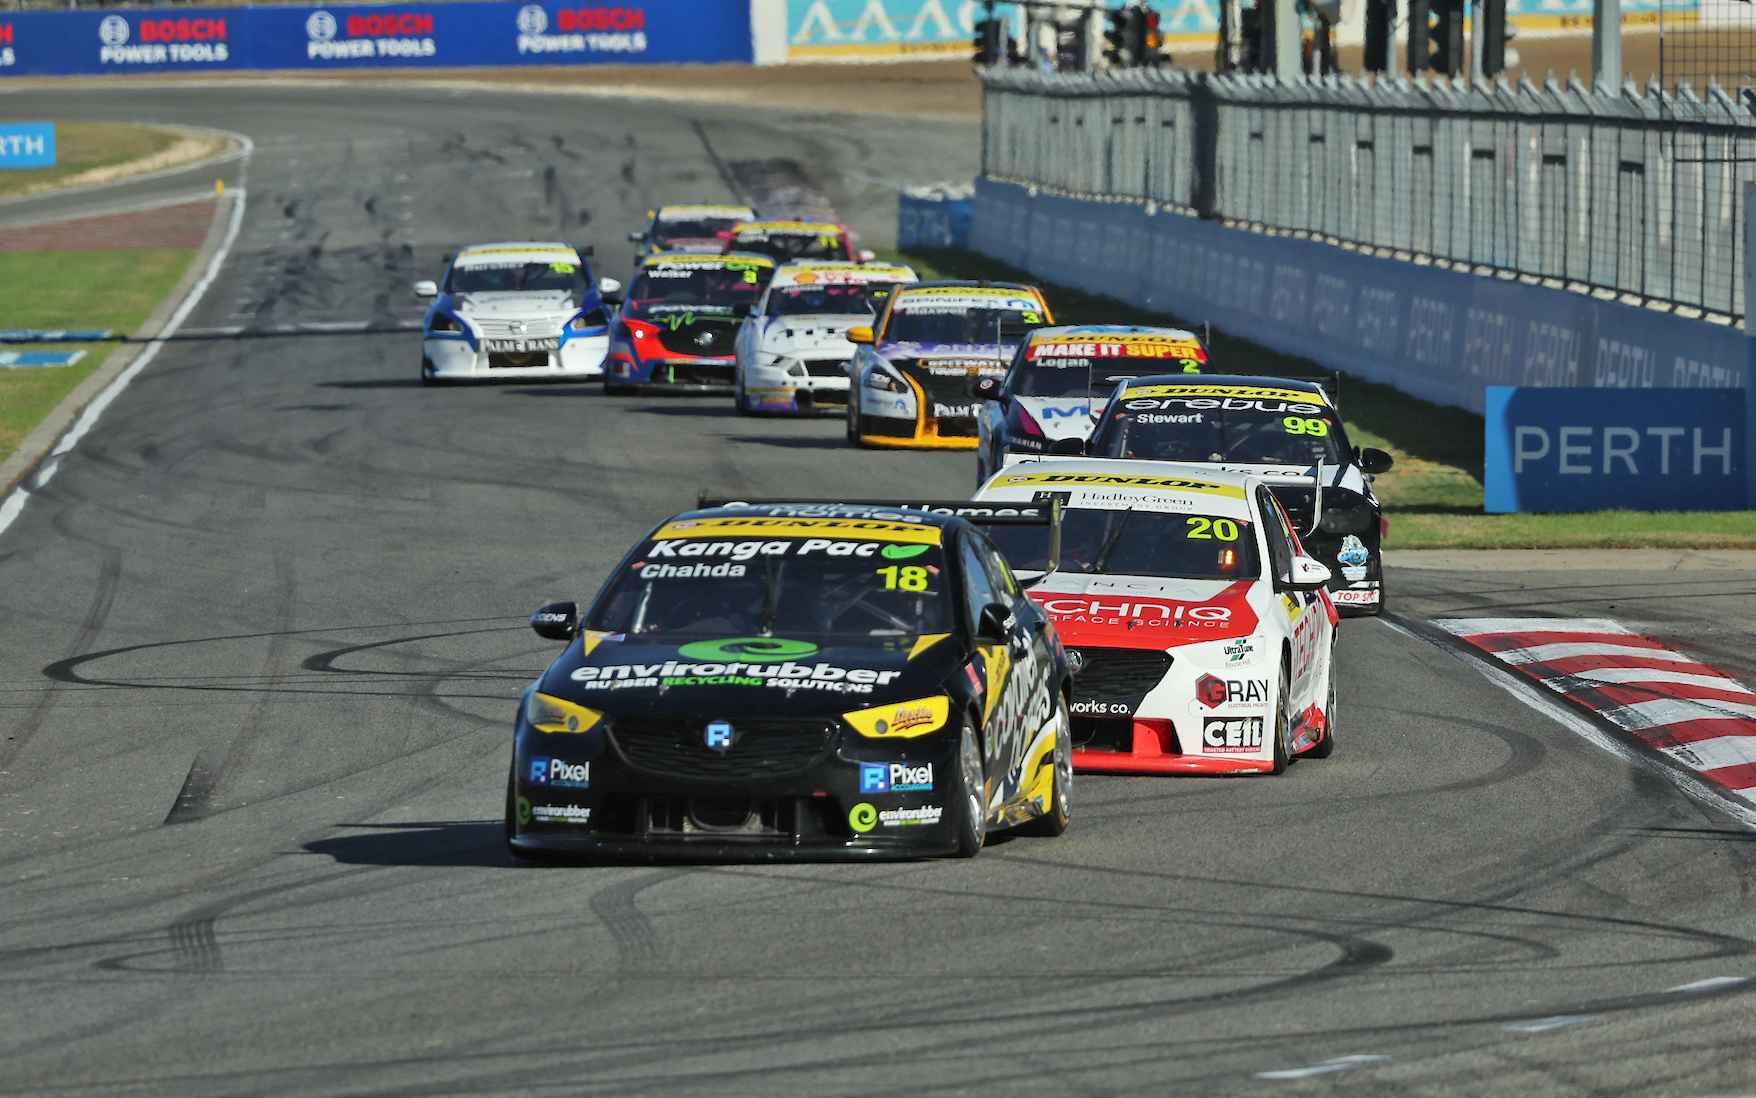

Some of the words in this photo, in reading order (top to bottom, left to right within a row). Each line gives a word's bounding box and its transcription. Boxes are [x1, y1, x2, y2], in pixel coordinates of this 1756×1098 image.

[348, 14, 433, 36] BOSCH
[558, 8, 644, 30] BOSCH
[140, 18, 226, 42] BOSCH
[307, 39, 375, 59] POWER
[378, 38, 436, 57] TOOLS
[517, 33, 585, 54] POWER
[587, 31, 646, 53] TOOLS
[101, 44, 167, 64] POWER
[169, 43, 229, 62] TOOLS
[1022, 311, 1041, 324] 3
[479, 339, 515, 353] PALM
[517, 338, 559, 352] TRANS
[1066, 336, 1189, 345] DUNLOP
[1034, 344, 1095, 357] MAKE
[1099, 343, 1121, 357] IT
[1126, 345, 1198, 359] SUPER
[1036, 358, 1089, 369] Logan
[1179, 359, 1201, 375] 2
[1165, 387, 1302, 398] DUNLOP
[934, 403, 969, 418] PALM
[1125, 399, 1322, 415] erebus
[1137, 413, 1204, 424] Stewart
[1283, 416, 1328, 437] 99
[1514, 425, 1731, 474] PERTH
[1040, 474, 1221, 490] DUNLOP
[710, 520, 927, 533] DUNLOP
[1186, 517, 1239, 542] 20
[647, 538, 792, 561] Kanga
[796, 539, 881, 557] Pac
[640, 563, 746, 578] Chahda
[876, 565, 928, 592] 18
[1338, 592, 1359, 601] TOP
[570, 660, 901, 685] envirorubber
[585, 678, 658, 690] RUBBER
[662, 676, 763, 686] RECYCLING
[766, 677, 873, 693] SOLUTIONS
[1207, 680, 1268, 703] GRAY
[1110, 704, 1131, 714] co.
[550, 758, 590, 781] Pixel
[890, 762, 933, 785] Pixel
[532, 803, 591, 817] envirorubber
[879, 805, 943, 821] envirorubber
